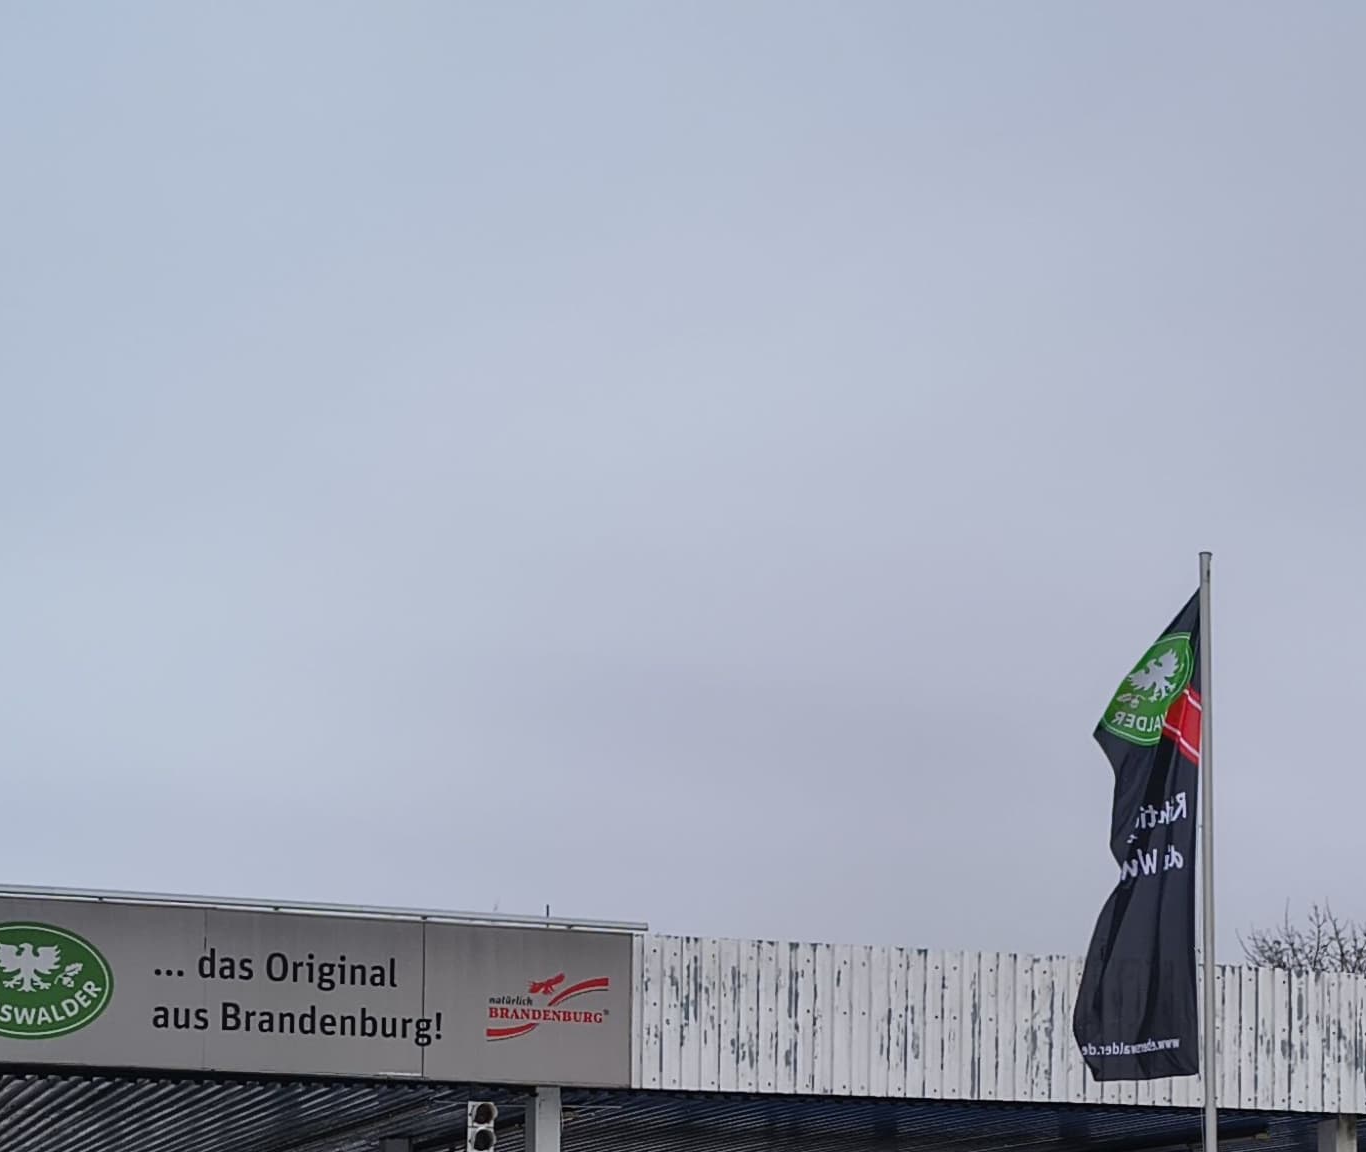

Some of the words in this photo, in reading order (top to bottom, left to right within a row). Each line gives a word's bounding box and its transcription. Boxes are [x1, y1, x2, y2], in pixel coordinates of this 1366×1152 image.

[197, 948, 254, 981] das
[266, 952, 398, 991] Original
[152, 1004, 209, 1029] aus
[221, 1002, 442, 1047] Brandenburg!
